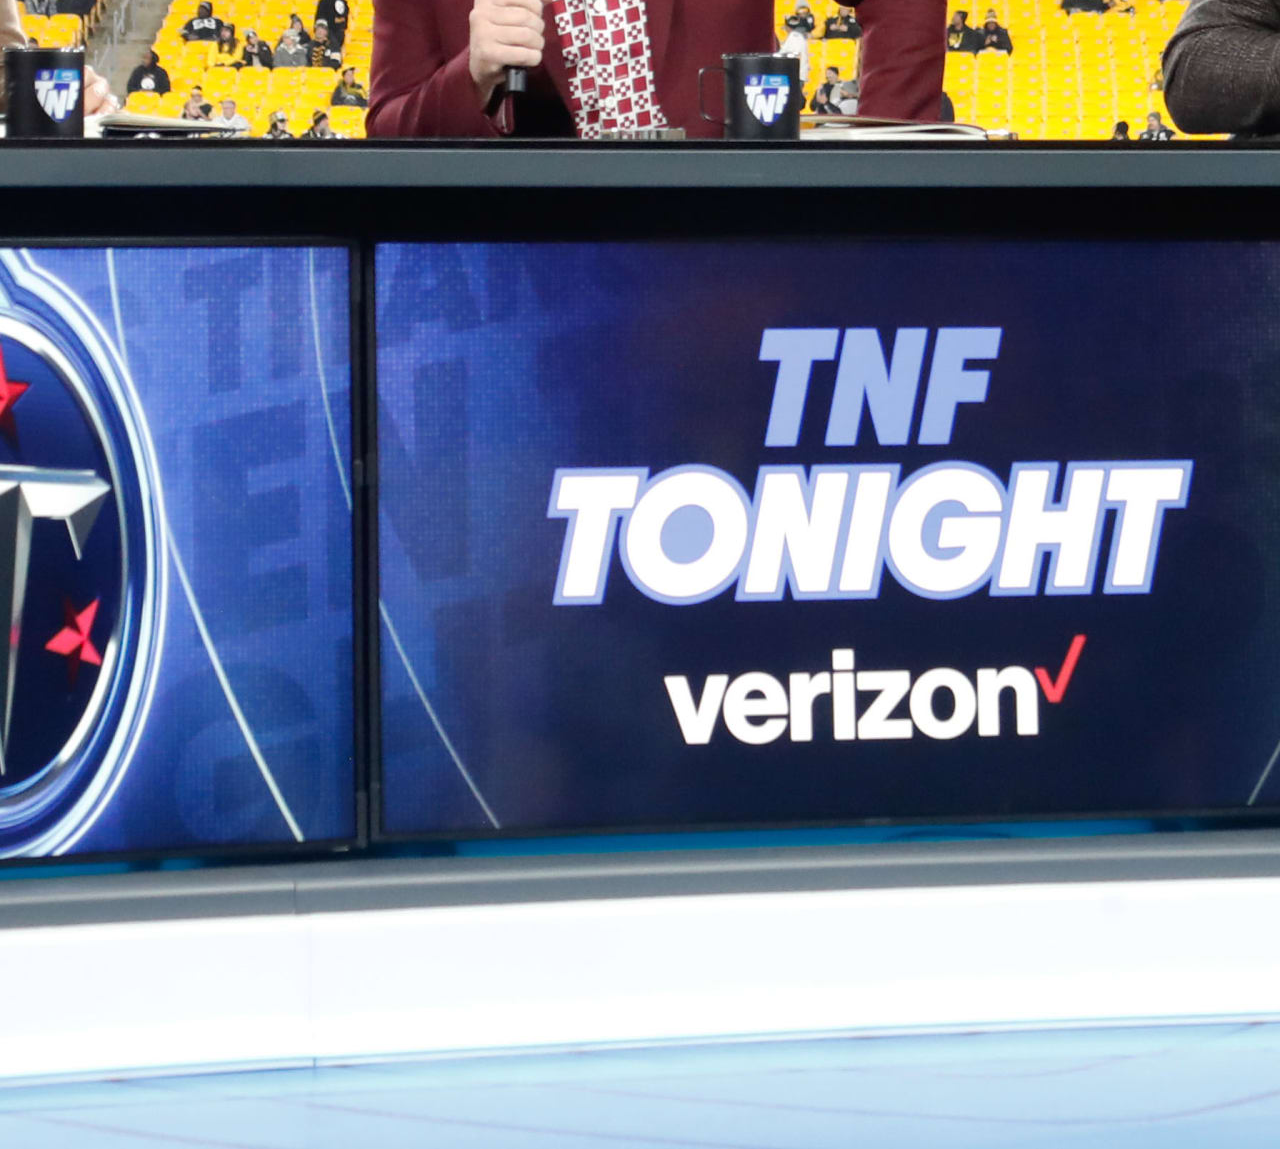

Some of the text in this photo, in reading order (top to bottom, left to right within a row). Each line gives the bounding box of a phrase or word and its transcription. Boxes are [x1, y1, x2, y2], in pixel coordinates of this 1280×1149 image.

[34, 80, 81, 120] TNF
[743, 85, 791, 124] TNF
[758, 326, 1004, 447] TNF
[546, 459, 1195, 606] TONIGHT
[664, 649, 1040, 745] verizon
